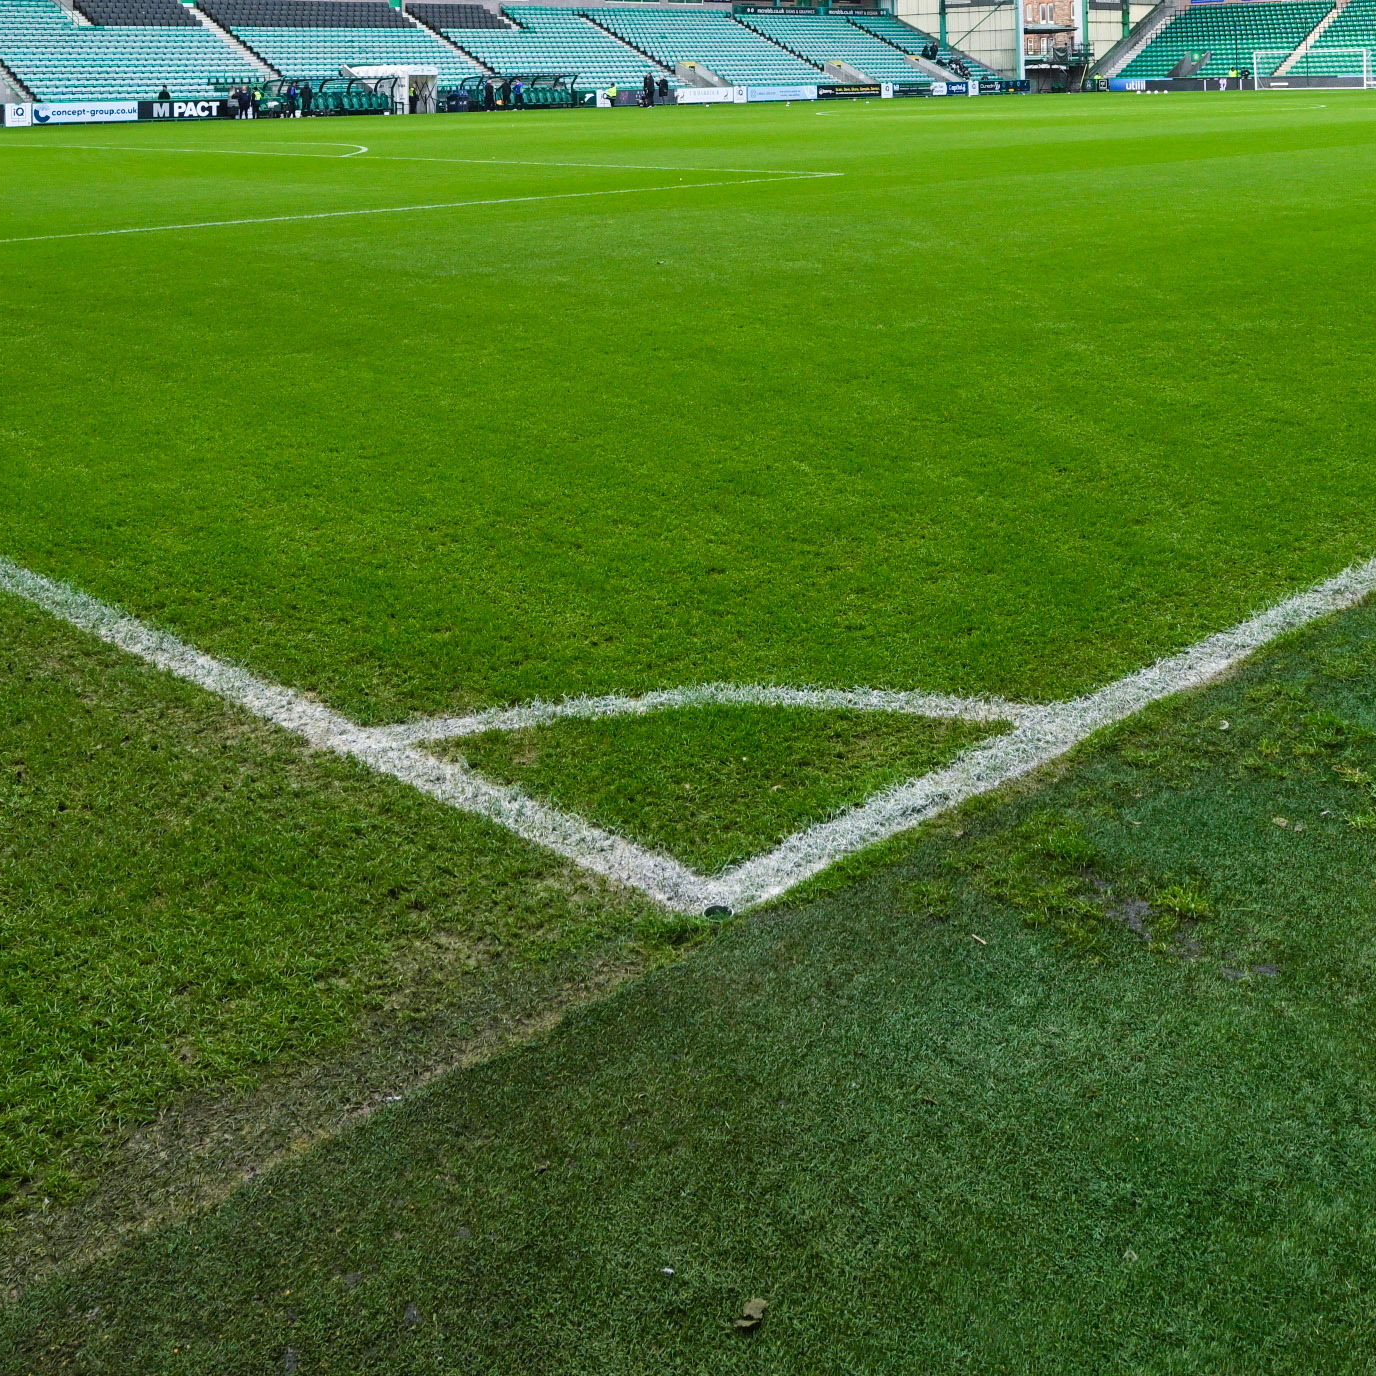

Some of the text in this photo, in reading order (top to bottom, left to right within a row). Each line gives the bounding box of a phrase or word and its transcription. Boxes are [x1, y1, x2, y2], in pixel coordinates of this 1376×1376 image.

[12, 107, 24, 117] iQ
[51, 106, 137, 118] concept-group.co.uk
[152, 102, 220, 118] M PACT
